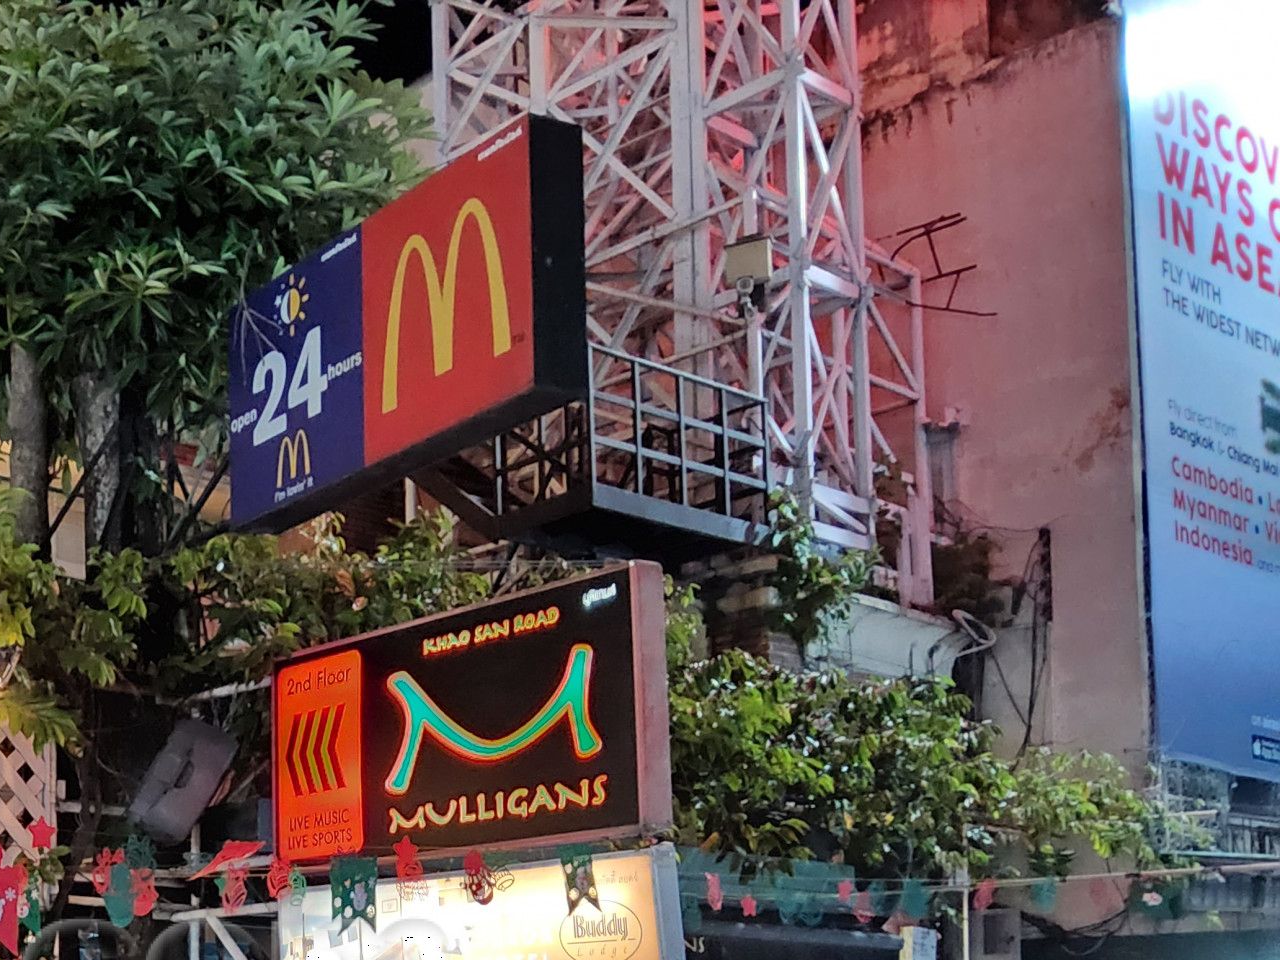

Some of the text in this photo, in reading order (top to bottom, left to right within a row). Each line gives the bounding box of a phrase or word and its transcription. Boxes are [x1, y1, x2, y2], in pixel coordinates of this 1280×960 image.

[1156, 131, 1255, 227] WAYS
[1158, 190, 1196, 255] IN
[1210, 222, 1280, 297] ASE
[1161, 257, 1222, 305] FLY WITH
[1162, 285, 1280, 358] THE WIDEST NETW
[230, 325, 363, 447] open 24 hours
[1169, 421, 1215, 452] Bangkok
[1227, 445, 1261, 474] Chiang
[1171, 456, 1254, 505] Cambodia
[1173, 487, 1280, 544] Myanmar Vi
[1174, 520, 1254, 566] Indonesia
[422, 606, 560, 656] KHAO SAN ROAD
[287, 667, 352, 696] 2nd Floor
[289, 808, 350, 832] LIVE MUSIC
[388, 773, 609, 835] MULLIGANS
[288, 828, 353, 850] LIVE SPORTS
[572, 912, 629, 942] Buddy
